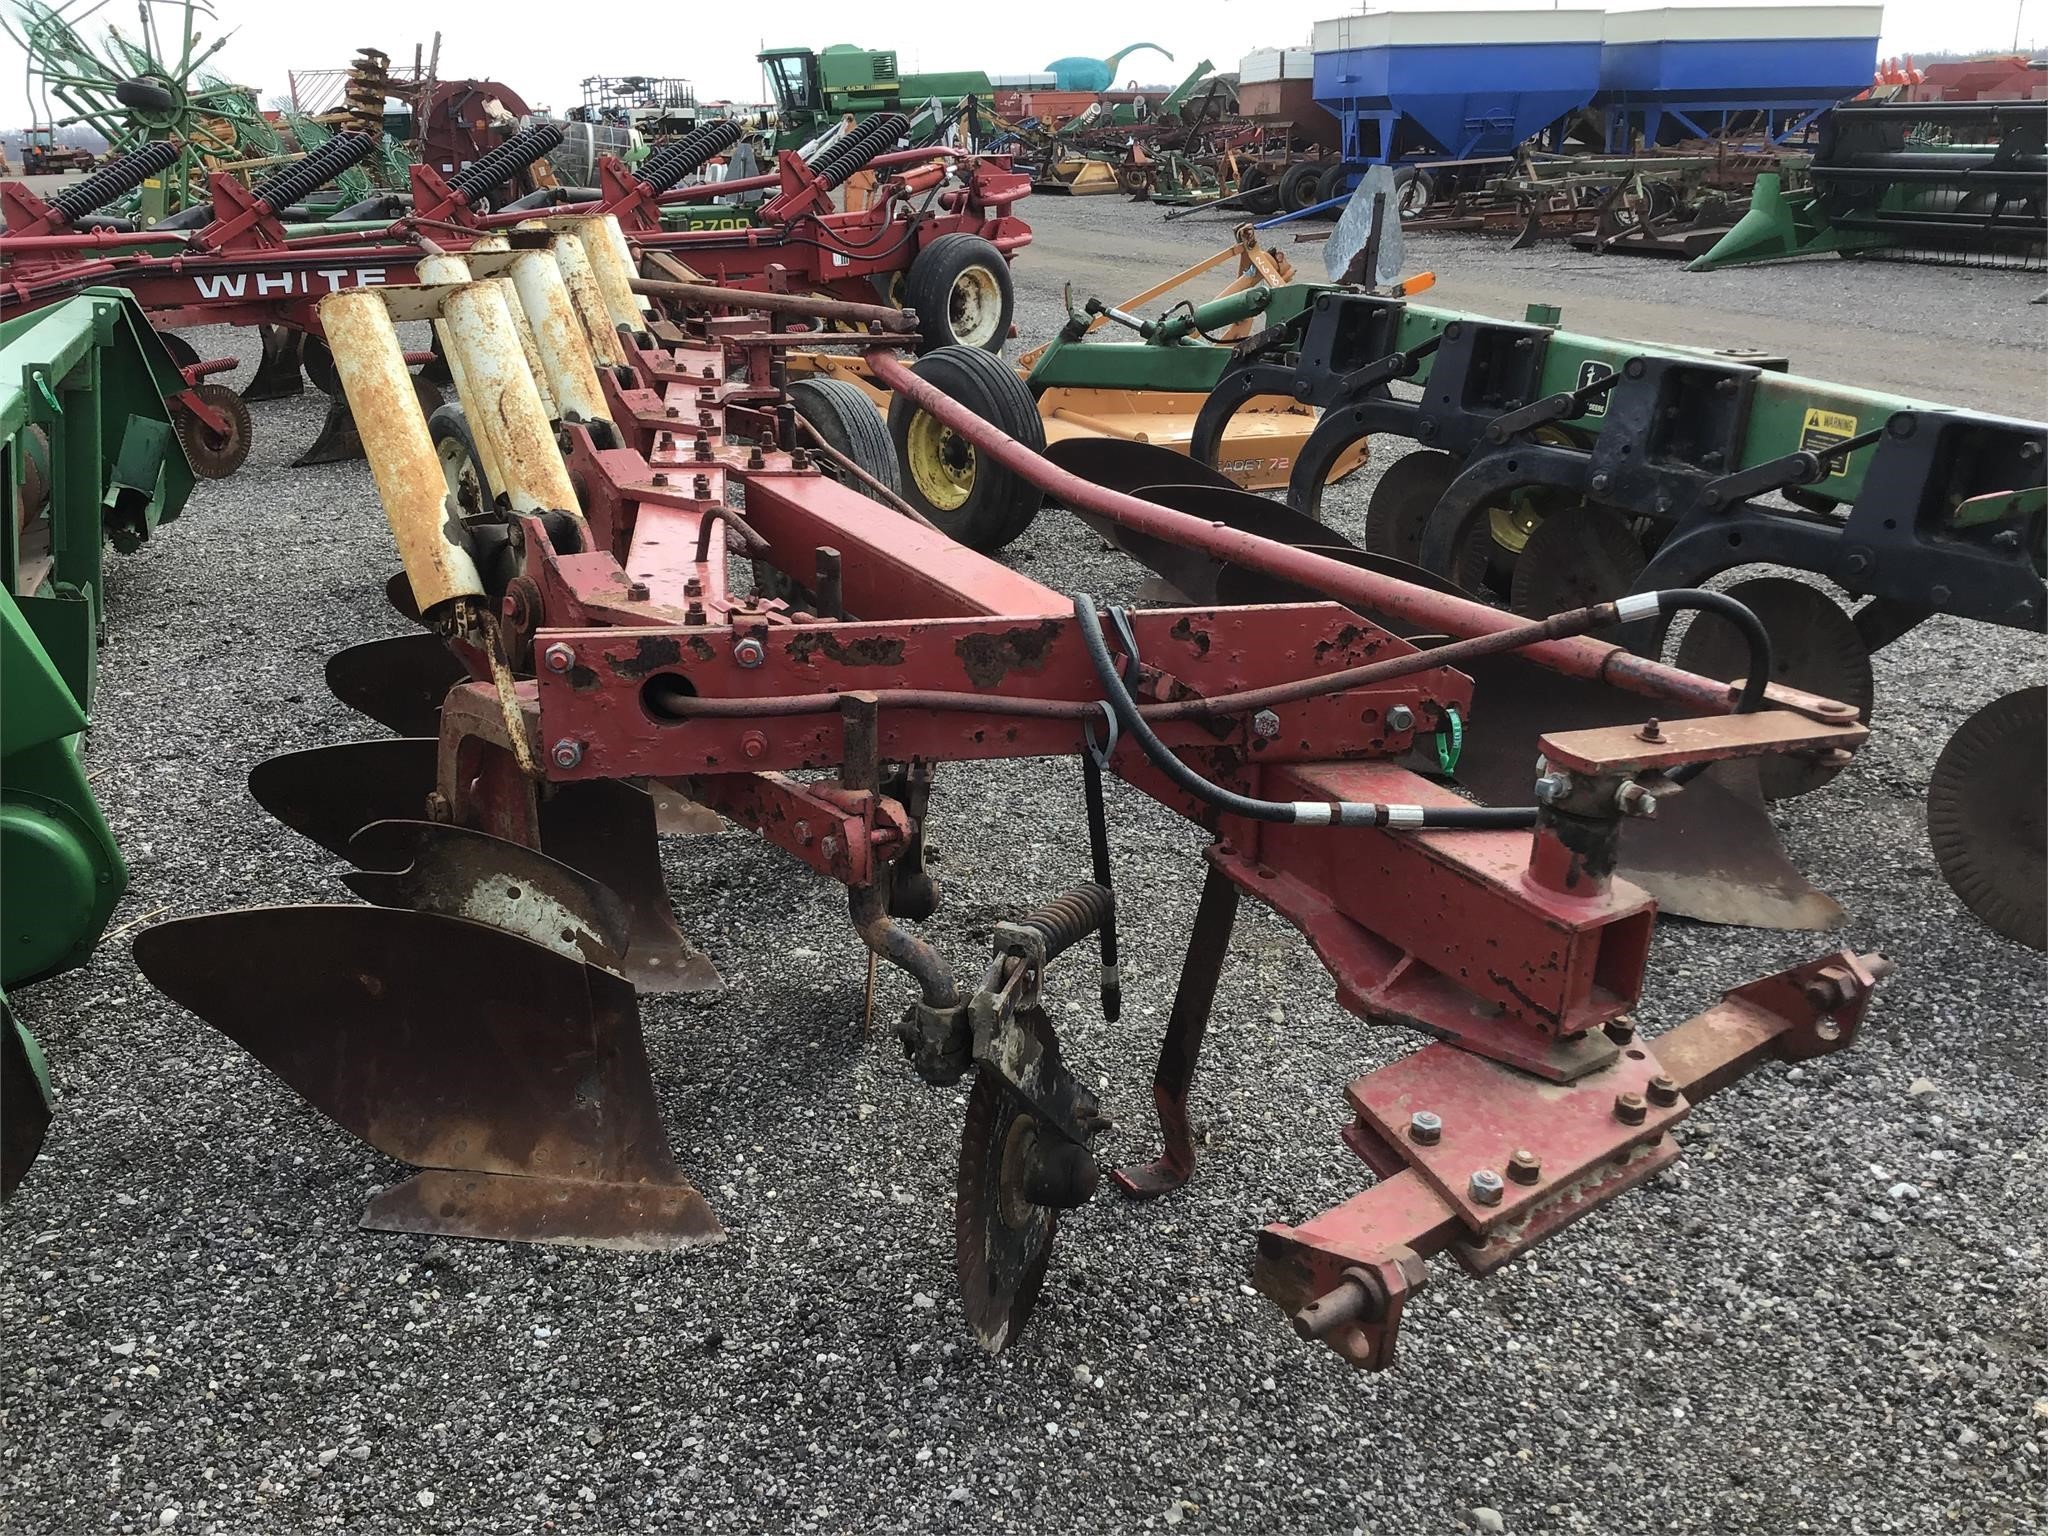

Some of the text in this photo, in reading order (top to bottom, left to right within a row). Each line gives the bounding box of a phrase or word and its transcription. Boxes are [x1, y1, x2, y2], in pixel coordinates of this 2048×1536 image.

[689, 218, 750, 232] 2700
[193, 268, 387, 299] WHITE
[1823, 415, 1854, 433] WARNING
[1268, 457, 1289, 470] 72
